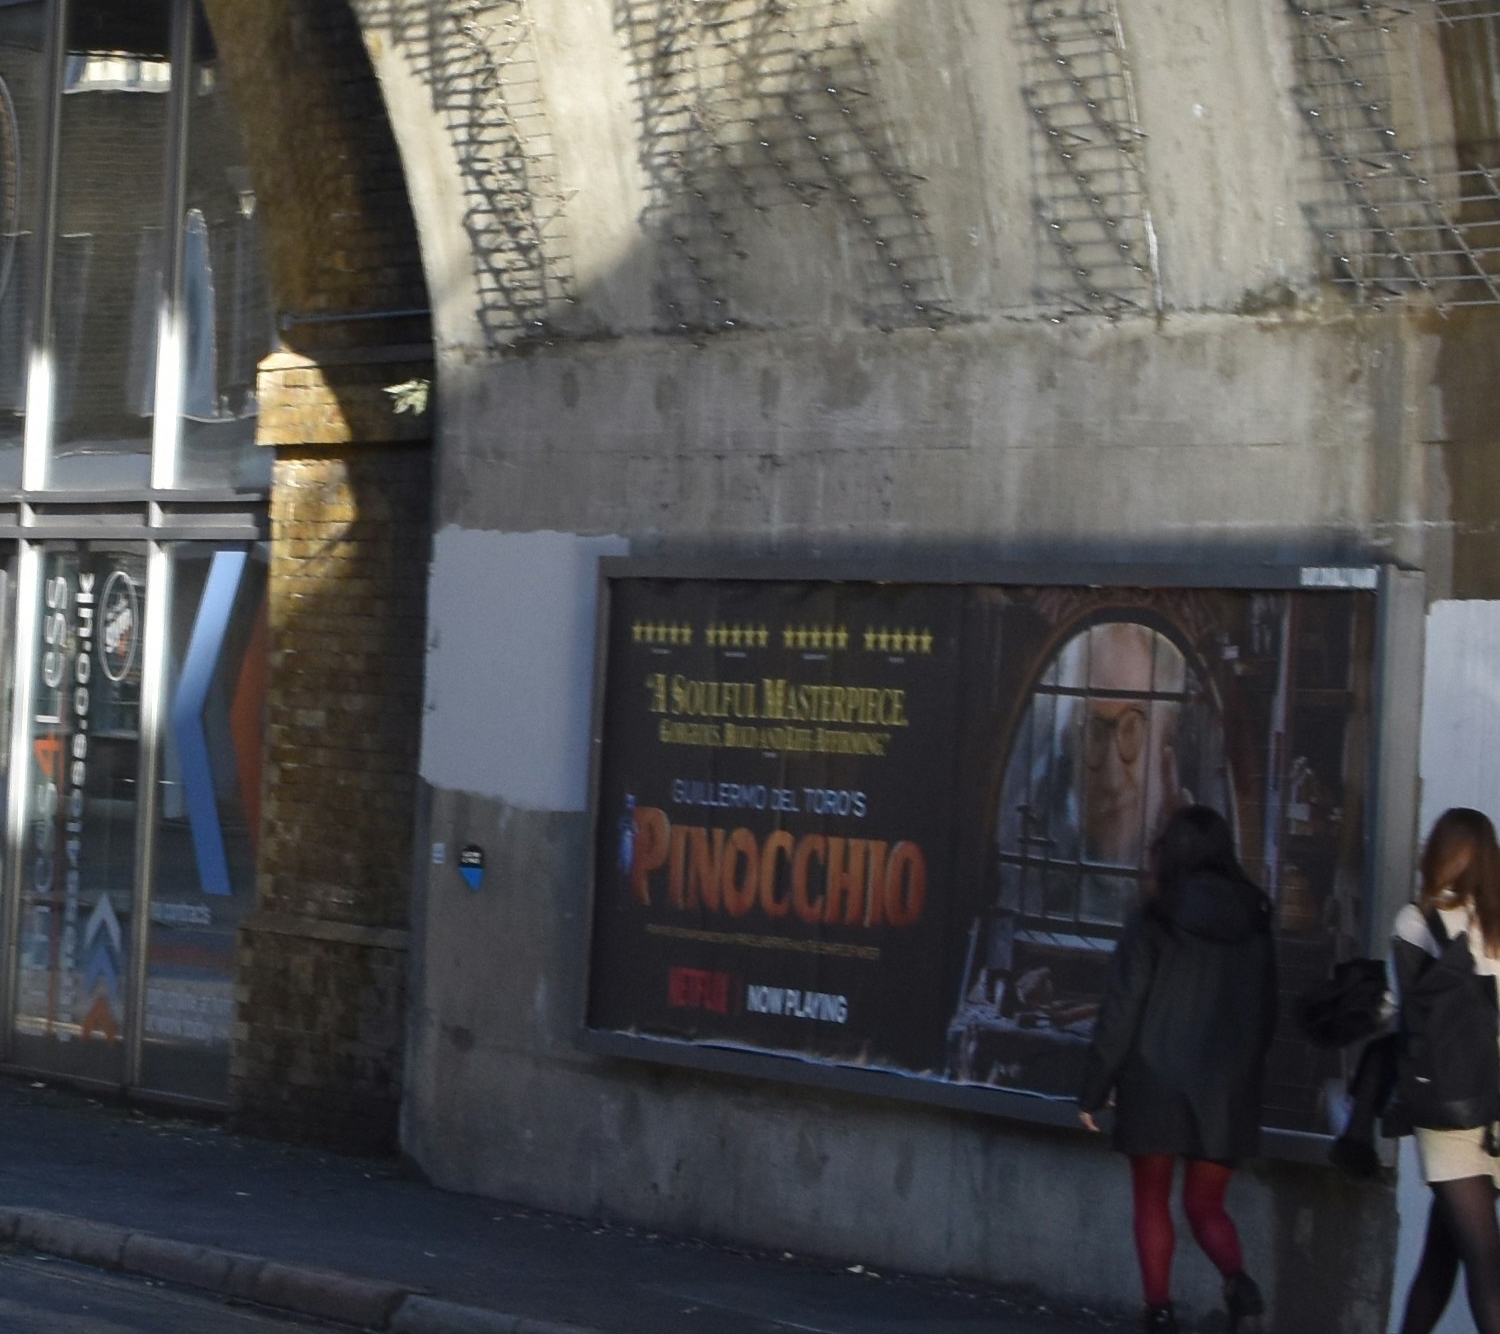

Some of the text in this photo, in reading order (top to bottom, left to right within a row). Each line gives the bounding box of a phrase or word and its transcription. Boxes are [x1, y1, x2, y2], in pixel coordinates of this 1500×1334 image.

[670, 674, 756, 717] SOULFUL
[672, 778, 766, 810] GUILLERMO
[770, 788, 800, 812] DEL
[631, 806, 926, 929] PINOCCHIO
[747, 984, 848, 1024] NOW PLAYING
